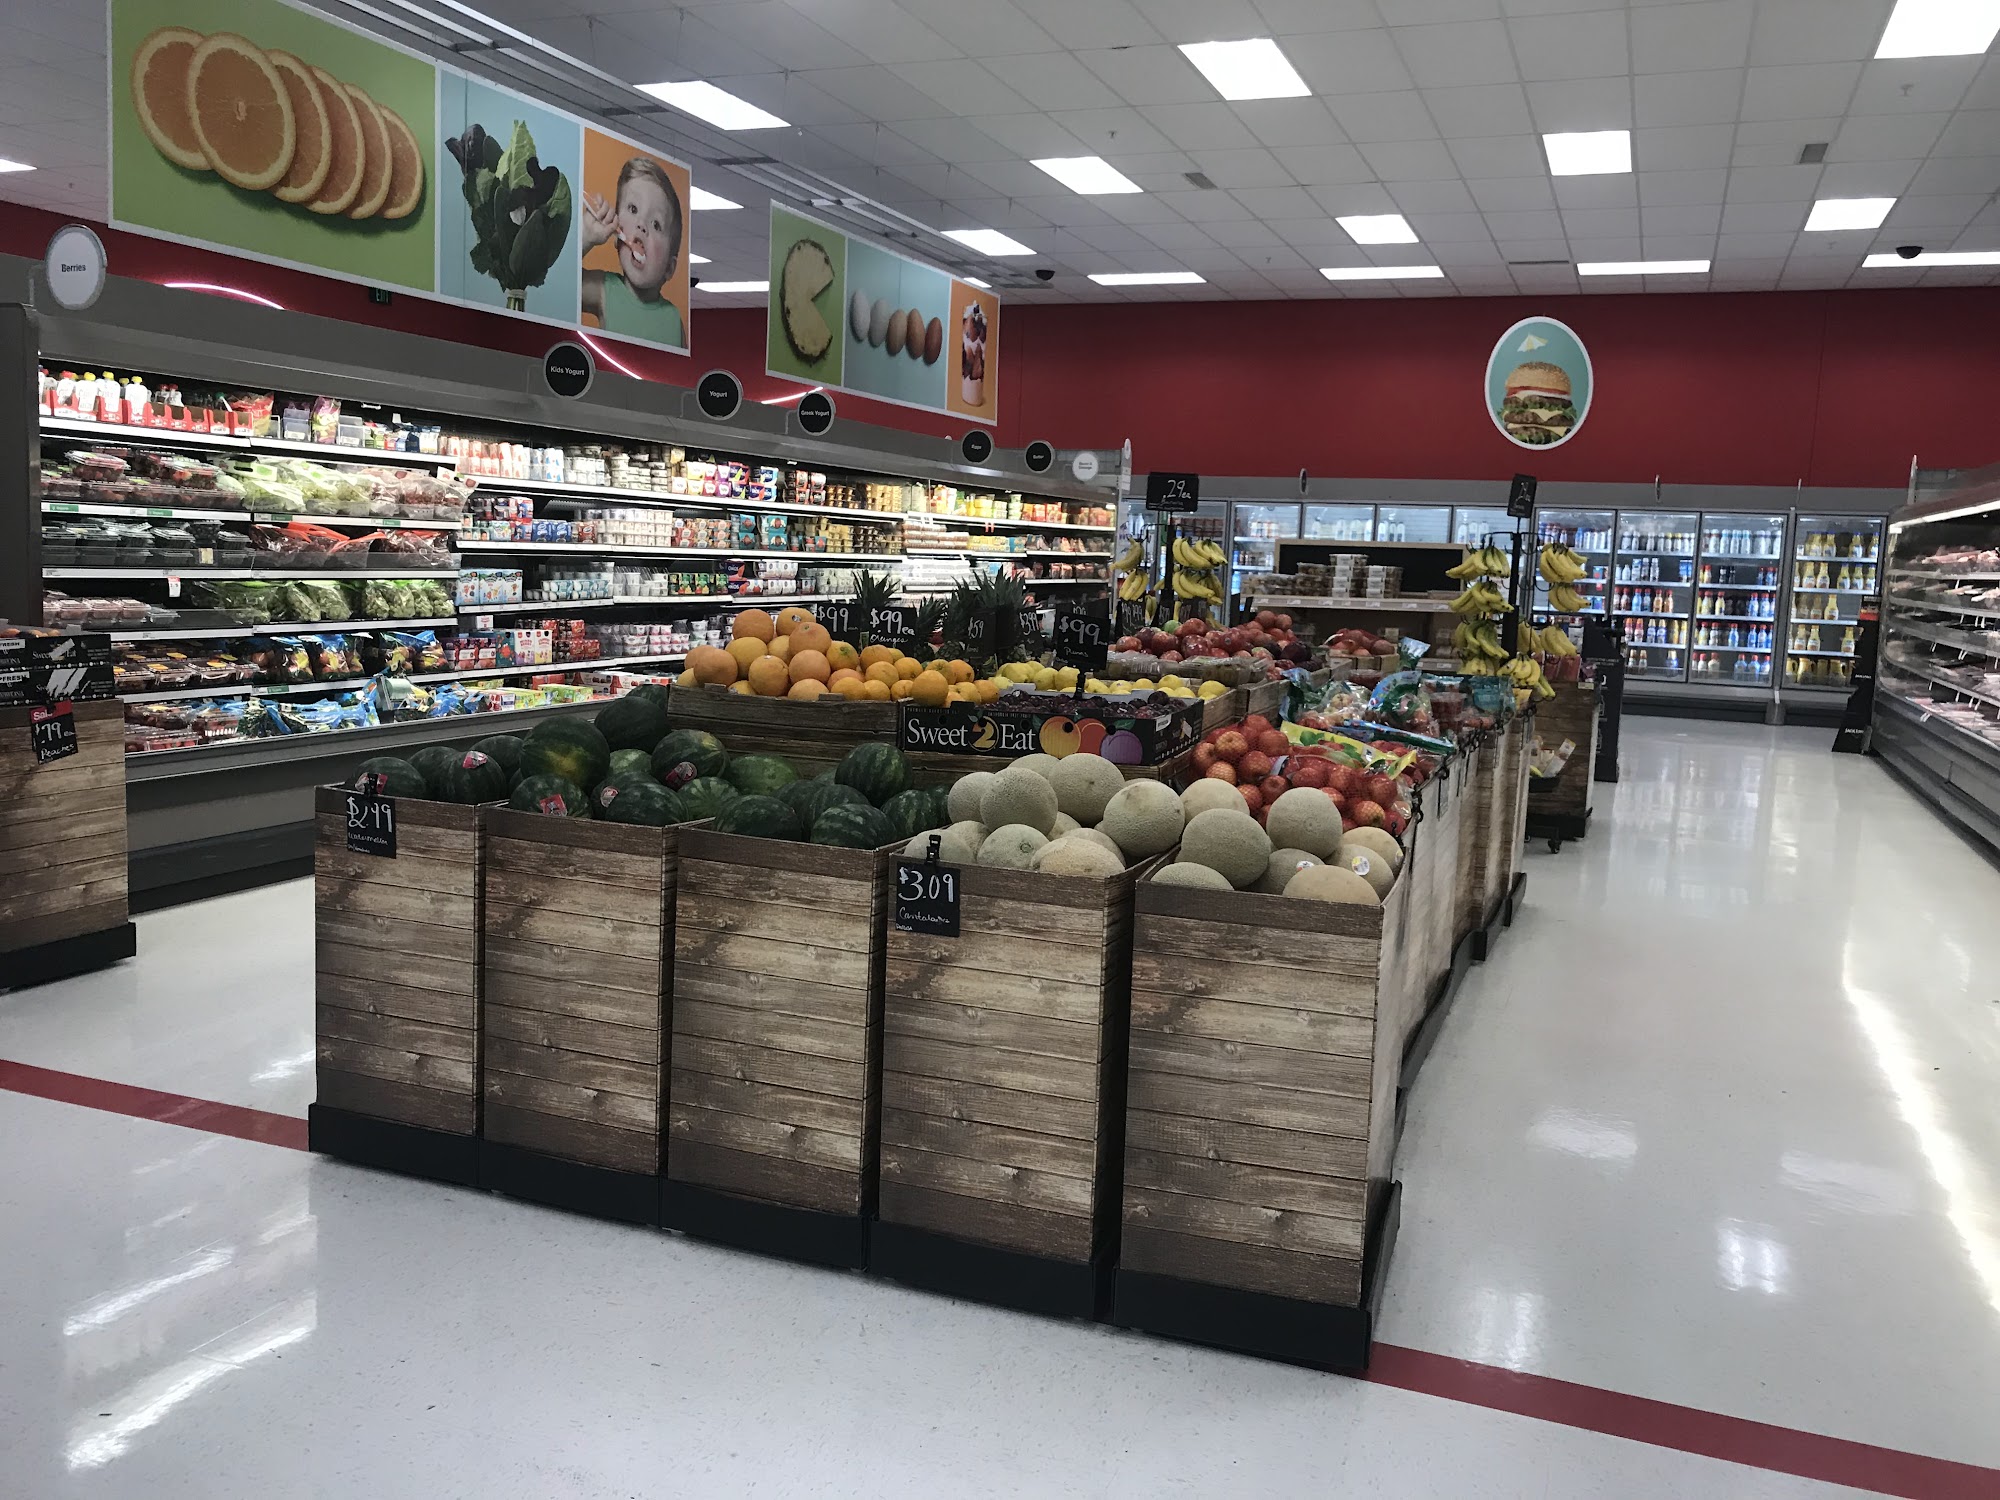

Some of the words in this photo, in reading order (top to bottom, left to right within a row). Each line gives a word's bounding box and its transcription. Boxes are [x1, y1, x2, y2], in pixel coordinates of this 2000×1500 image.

[61, 263, 87, 273] Berries
[550, 366, 564, 374] Kids
[564, 367, 585, 376] Yogurt
[709, 390, 728, 399] Yogurt
[906, 718, 969, 747] Sweet
[999, 723, 1037, 751] Eat
[41, 743, 75, 760] Peaches
[898, 866, 954, 903] $3.09
